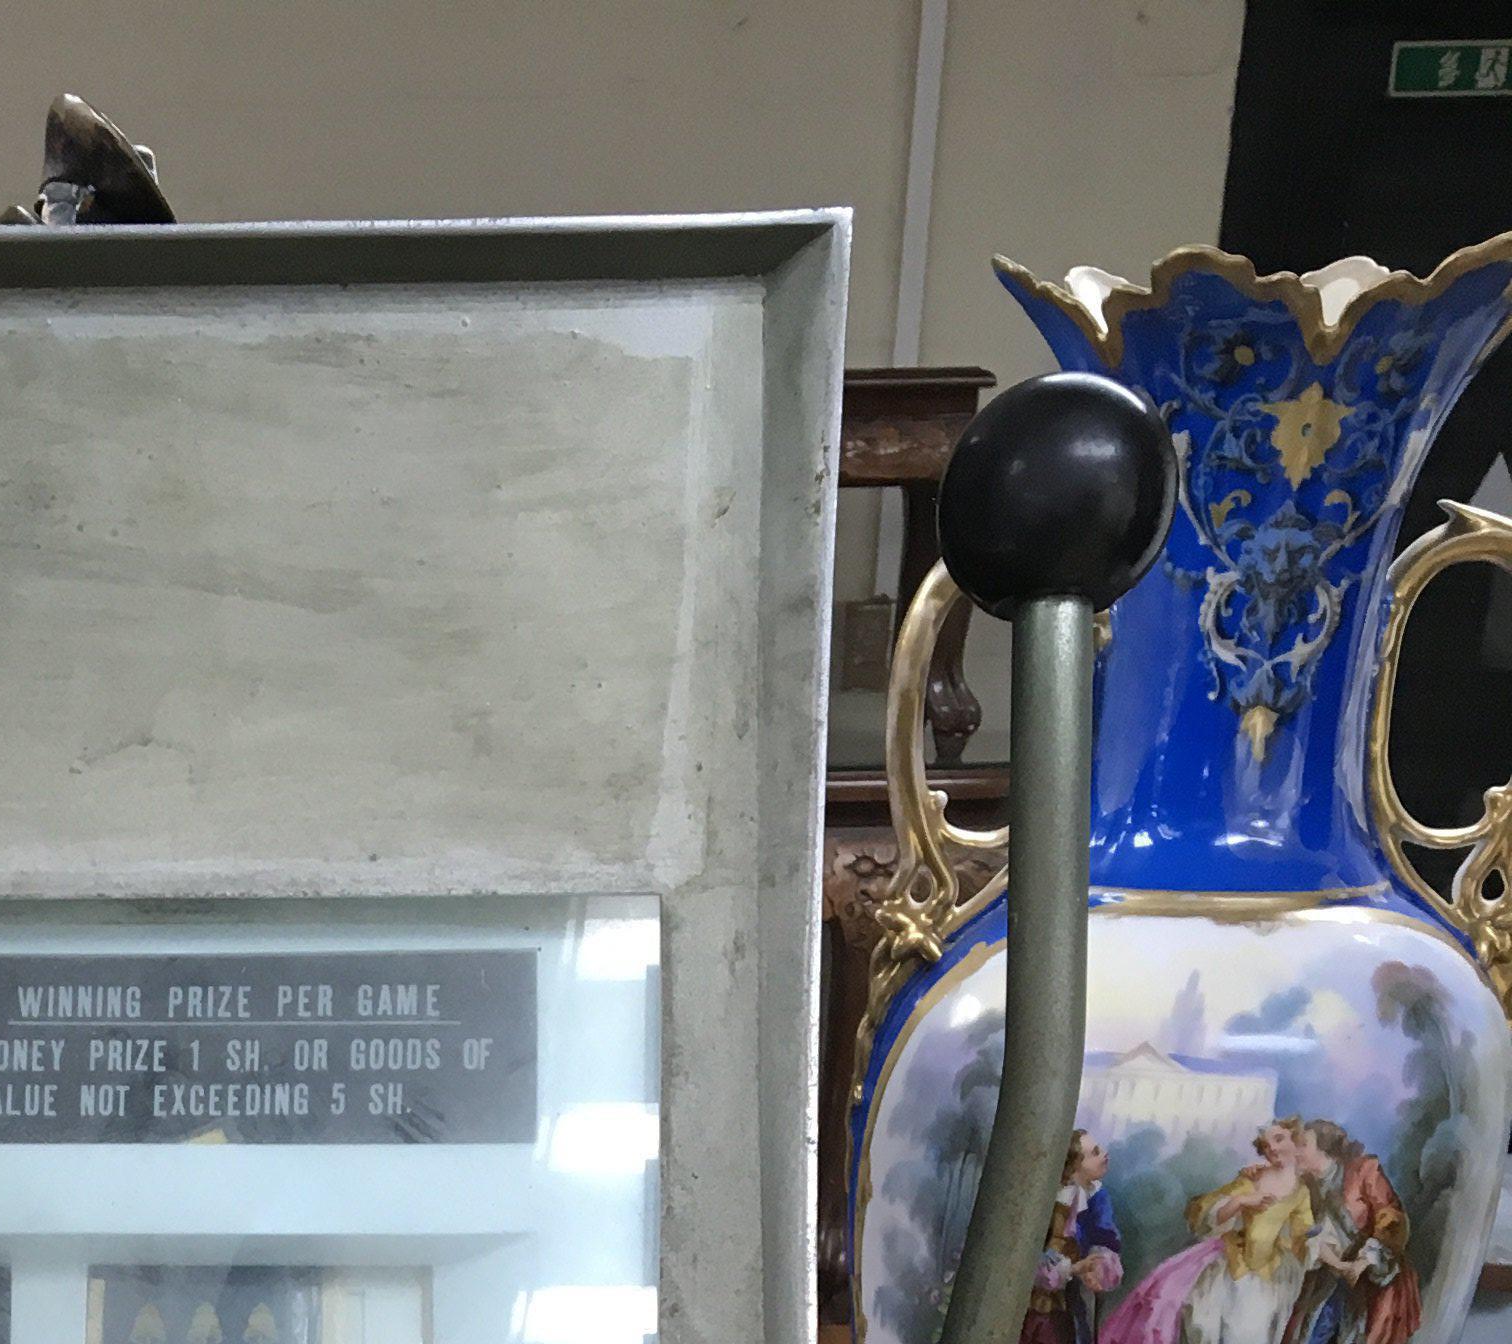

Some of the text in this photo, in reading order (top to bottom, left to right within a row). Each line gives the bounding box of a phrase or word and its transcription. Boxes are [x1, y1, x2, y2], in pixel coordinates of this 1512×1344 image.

[18, 984, 442, 1019] WINNING PRIZE PER GAME
[89, 1040, 169, 1072] PRIZE
[189, 1040, 201, 1071] 1
[225, 1040, 270, 1074] SH.
[294, 1040, 329, 1071] OR
[350, 1040, 442, 1071] GOODS
[462, 1039, 494, 1071] OF
[80, 1085, 131, 1118] NOT
[153, 1085, 310, 1118] EXCEEDING
[331, 1085, 346, 1115] 5
[368, 1085, 413, 1116] SH.
